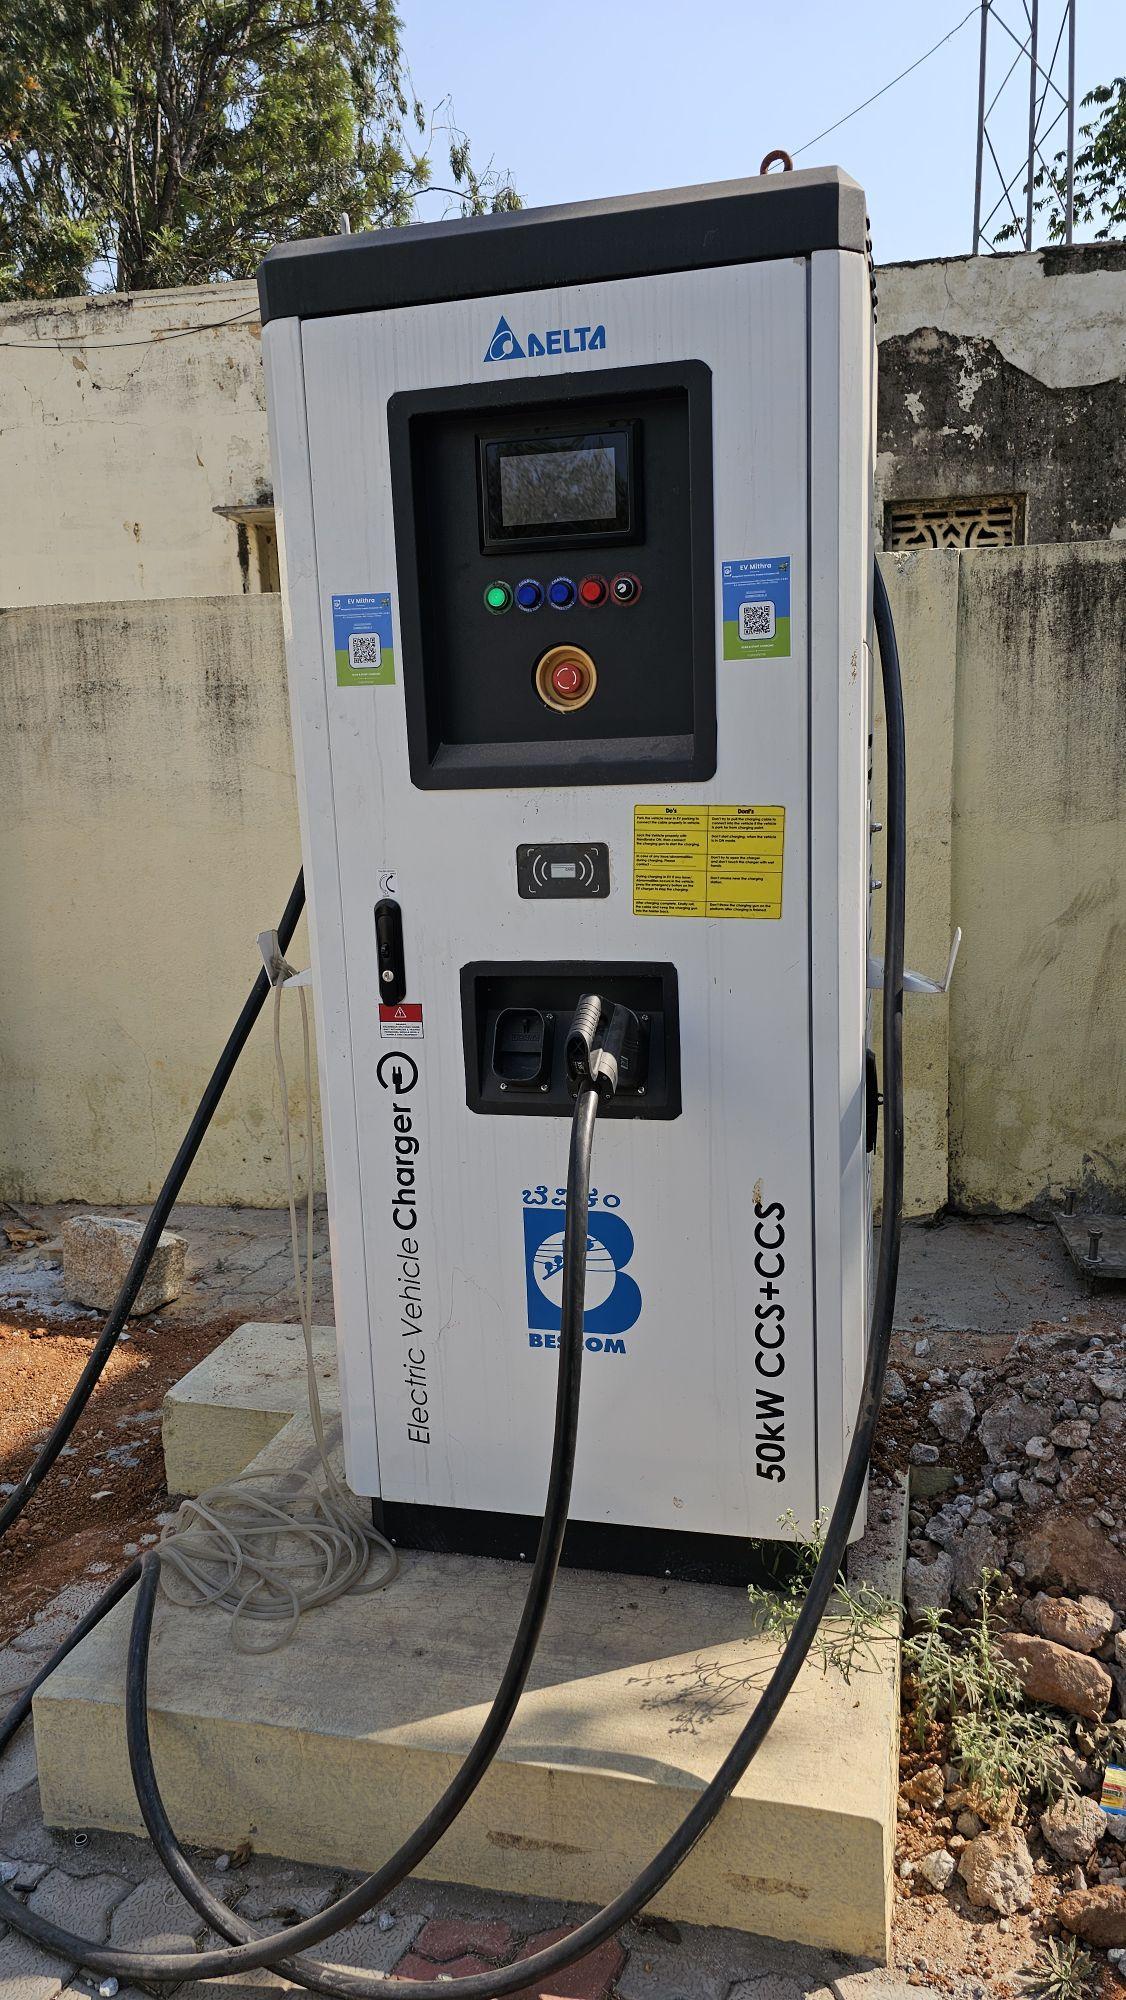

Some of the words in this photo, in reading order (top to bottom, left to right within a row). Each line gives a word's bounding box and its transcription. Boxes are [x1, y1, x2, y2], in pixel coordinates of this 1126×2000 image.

[527, 324, 606, 357] DELTA
[392, 1104, 420, 1231] Charger
[396, 1237, 422, 1338] Vehicle
[754, 1201, 785, 1378] CCS+CCS
[528, 1333, 626, 1354] BEOM
[403, 1348, 430, 1445] Electric
[755, 1388, 786, 1483] 50kW
